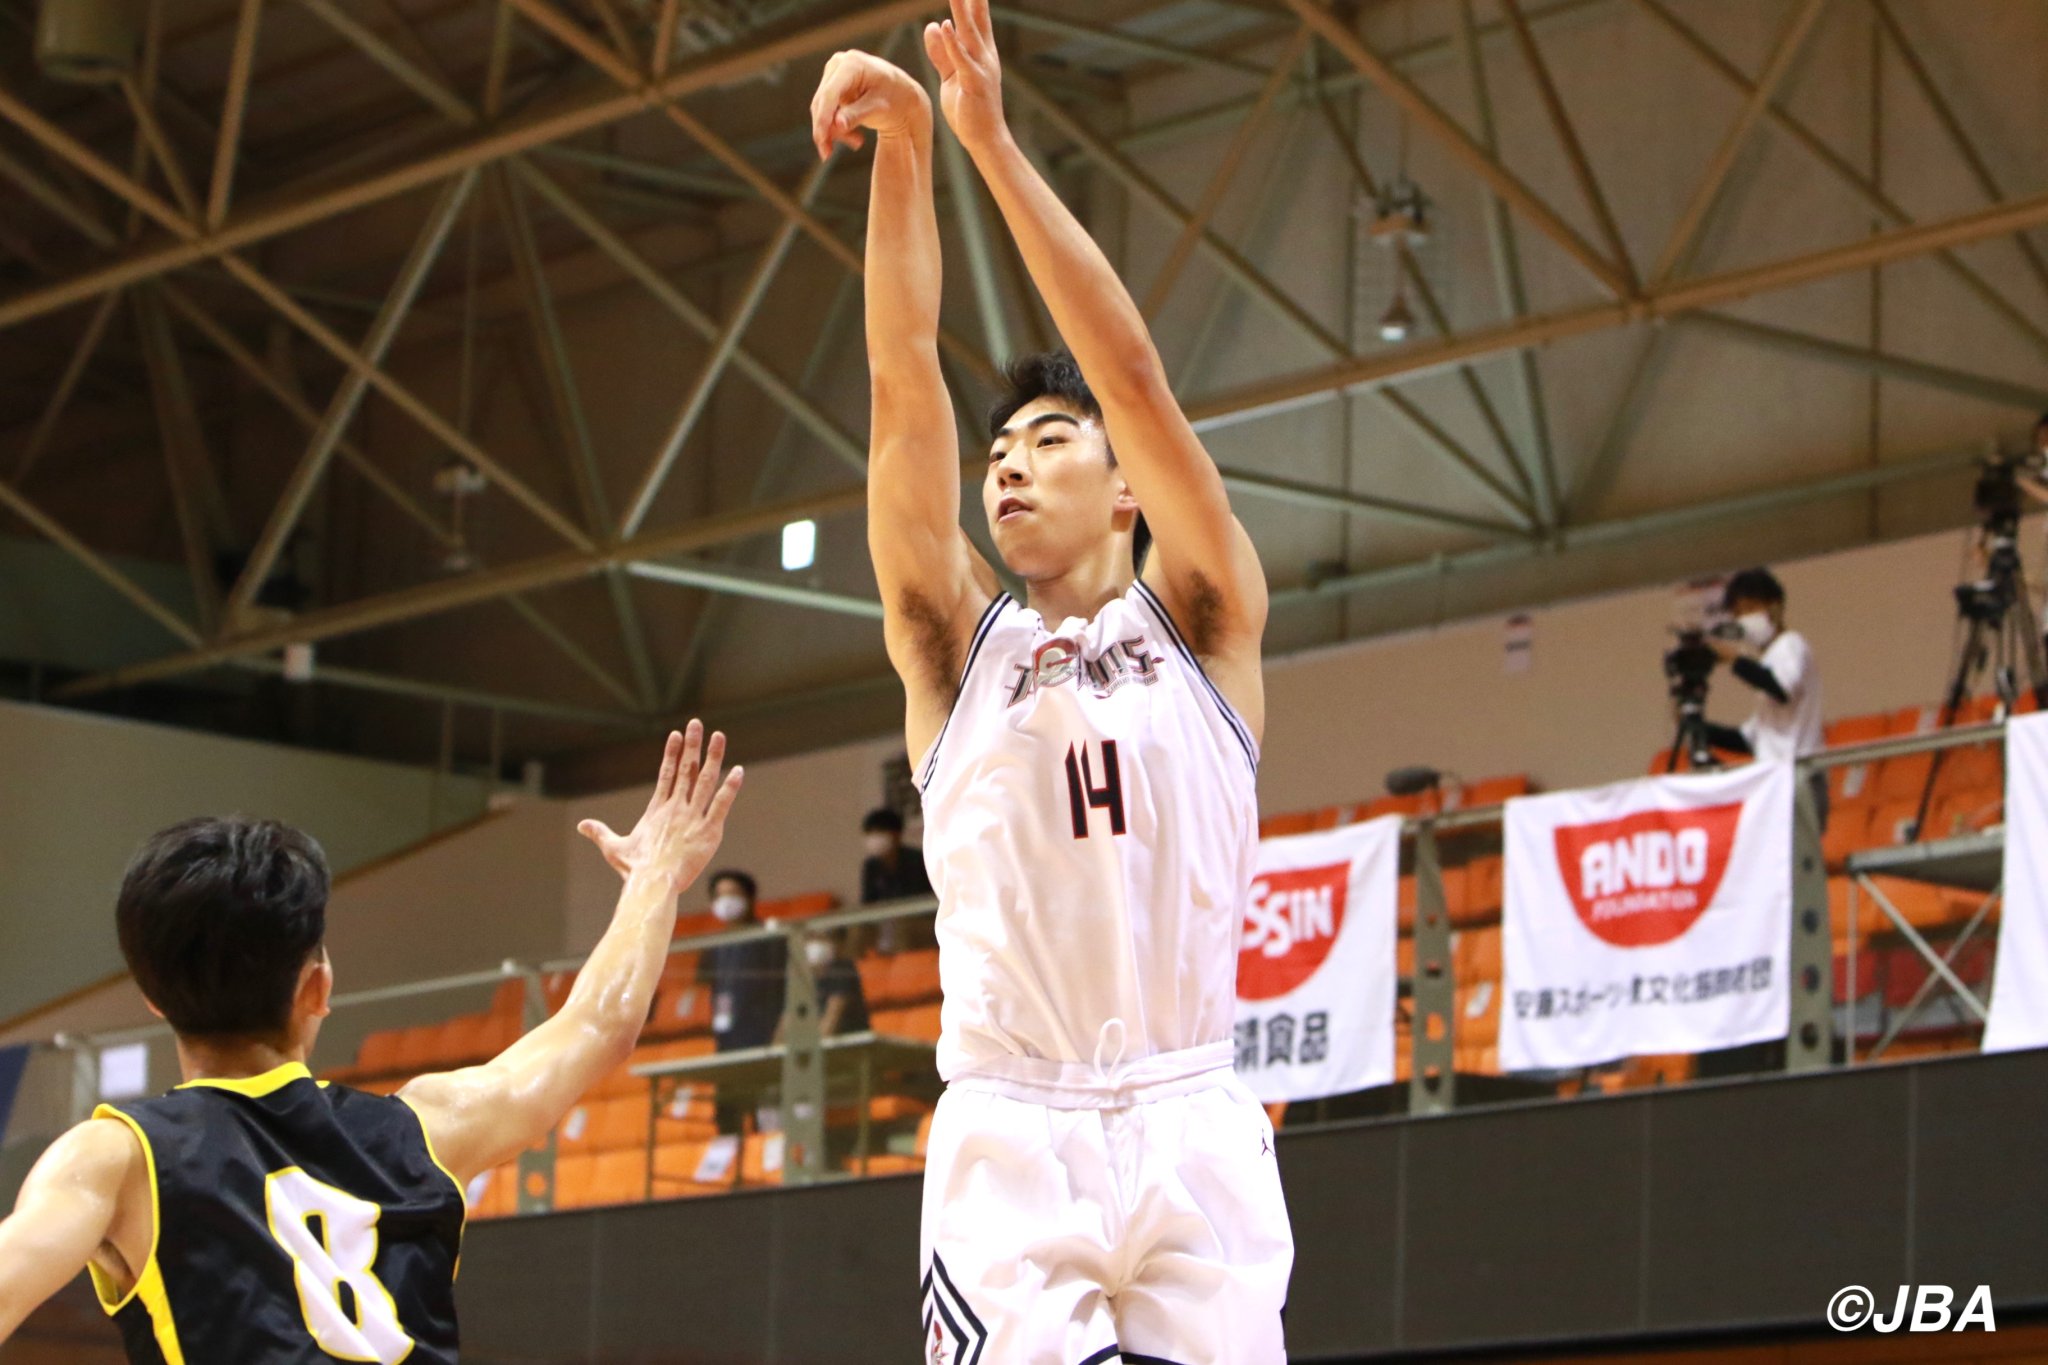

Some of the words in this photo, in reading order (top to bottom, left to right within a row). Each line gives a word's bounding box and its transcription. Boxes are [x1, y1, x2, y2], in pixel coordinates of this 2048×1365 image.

[1065, 739, 1126, 839] 14
[1580, 828, 1709, 900] ANDO
[265, 1166, 415, 1365] 8
